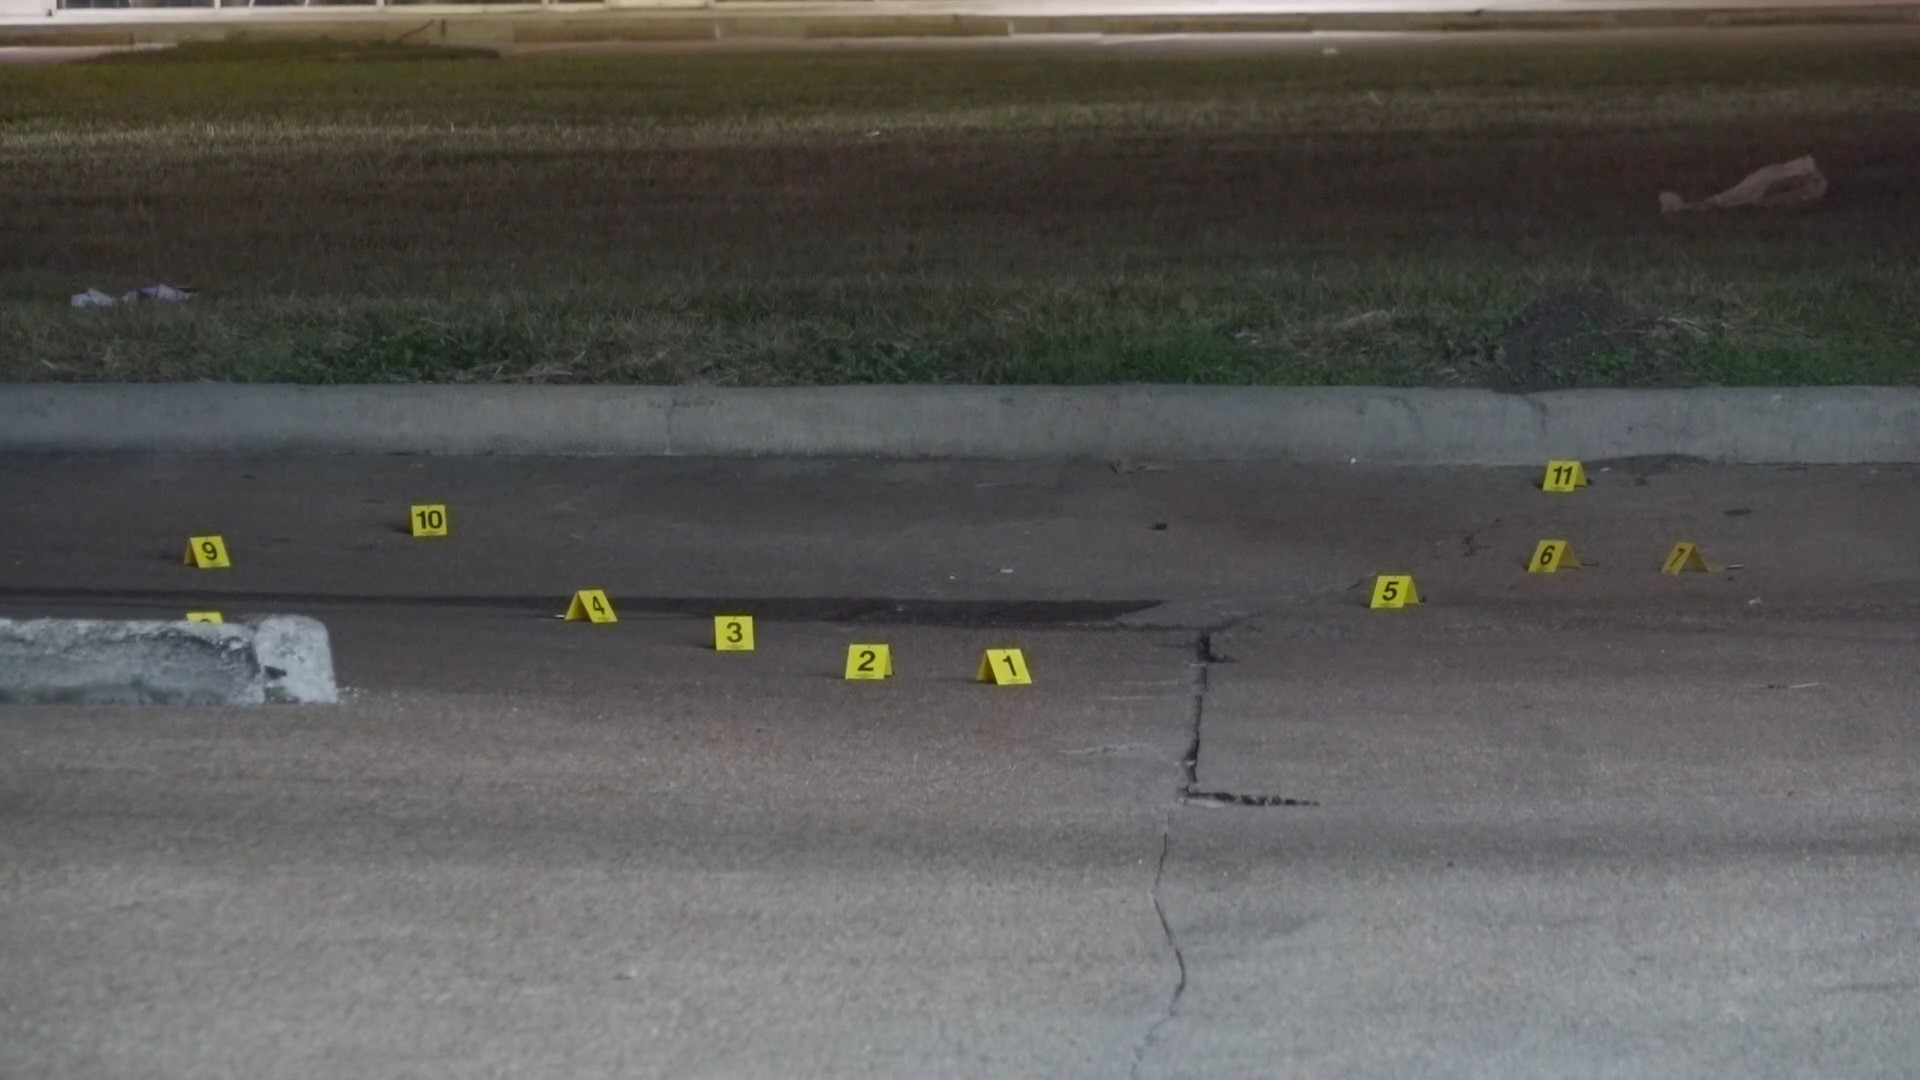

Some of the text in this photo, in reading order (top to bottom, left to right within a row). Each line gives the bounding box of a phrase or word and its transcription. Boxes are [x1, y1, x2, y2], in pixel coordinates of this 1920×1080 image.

[1553, 466, 1573, 486] 11
[416, 511, 443, 530] 10
[201, 541, 218, 561] 9
[1539, 545, 1555, 566] 6
[1669, 548, 1687, 568] 7
[1382, 581, 1399, 602] 5
[592, 595, 606, 616] 4
[726, 622, 743, 643] 3
[857, 650, 876, 672] 2
[1002, 655, 1017, 677] 1
